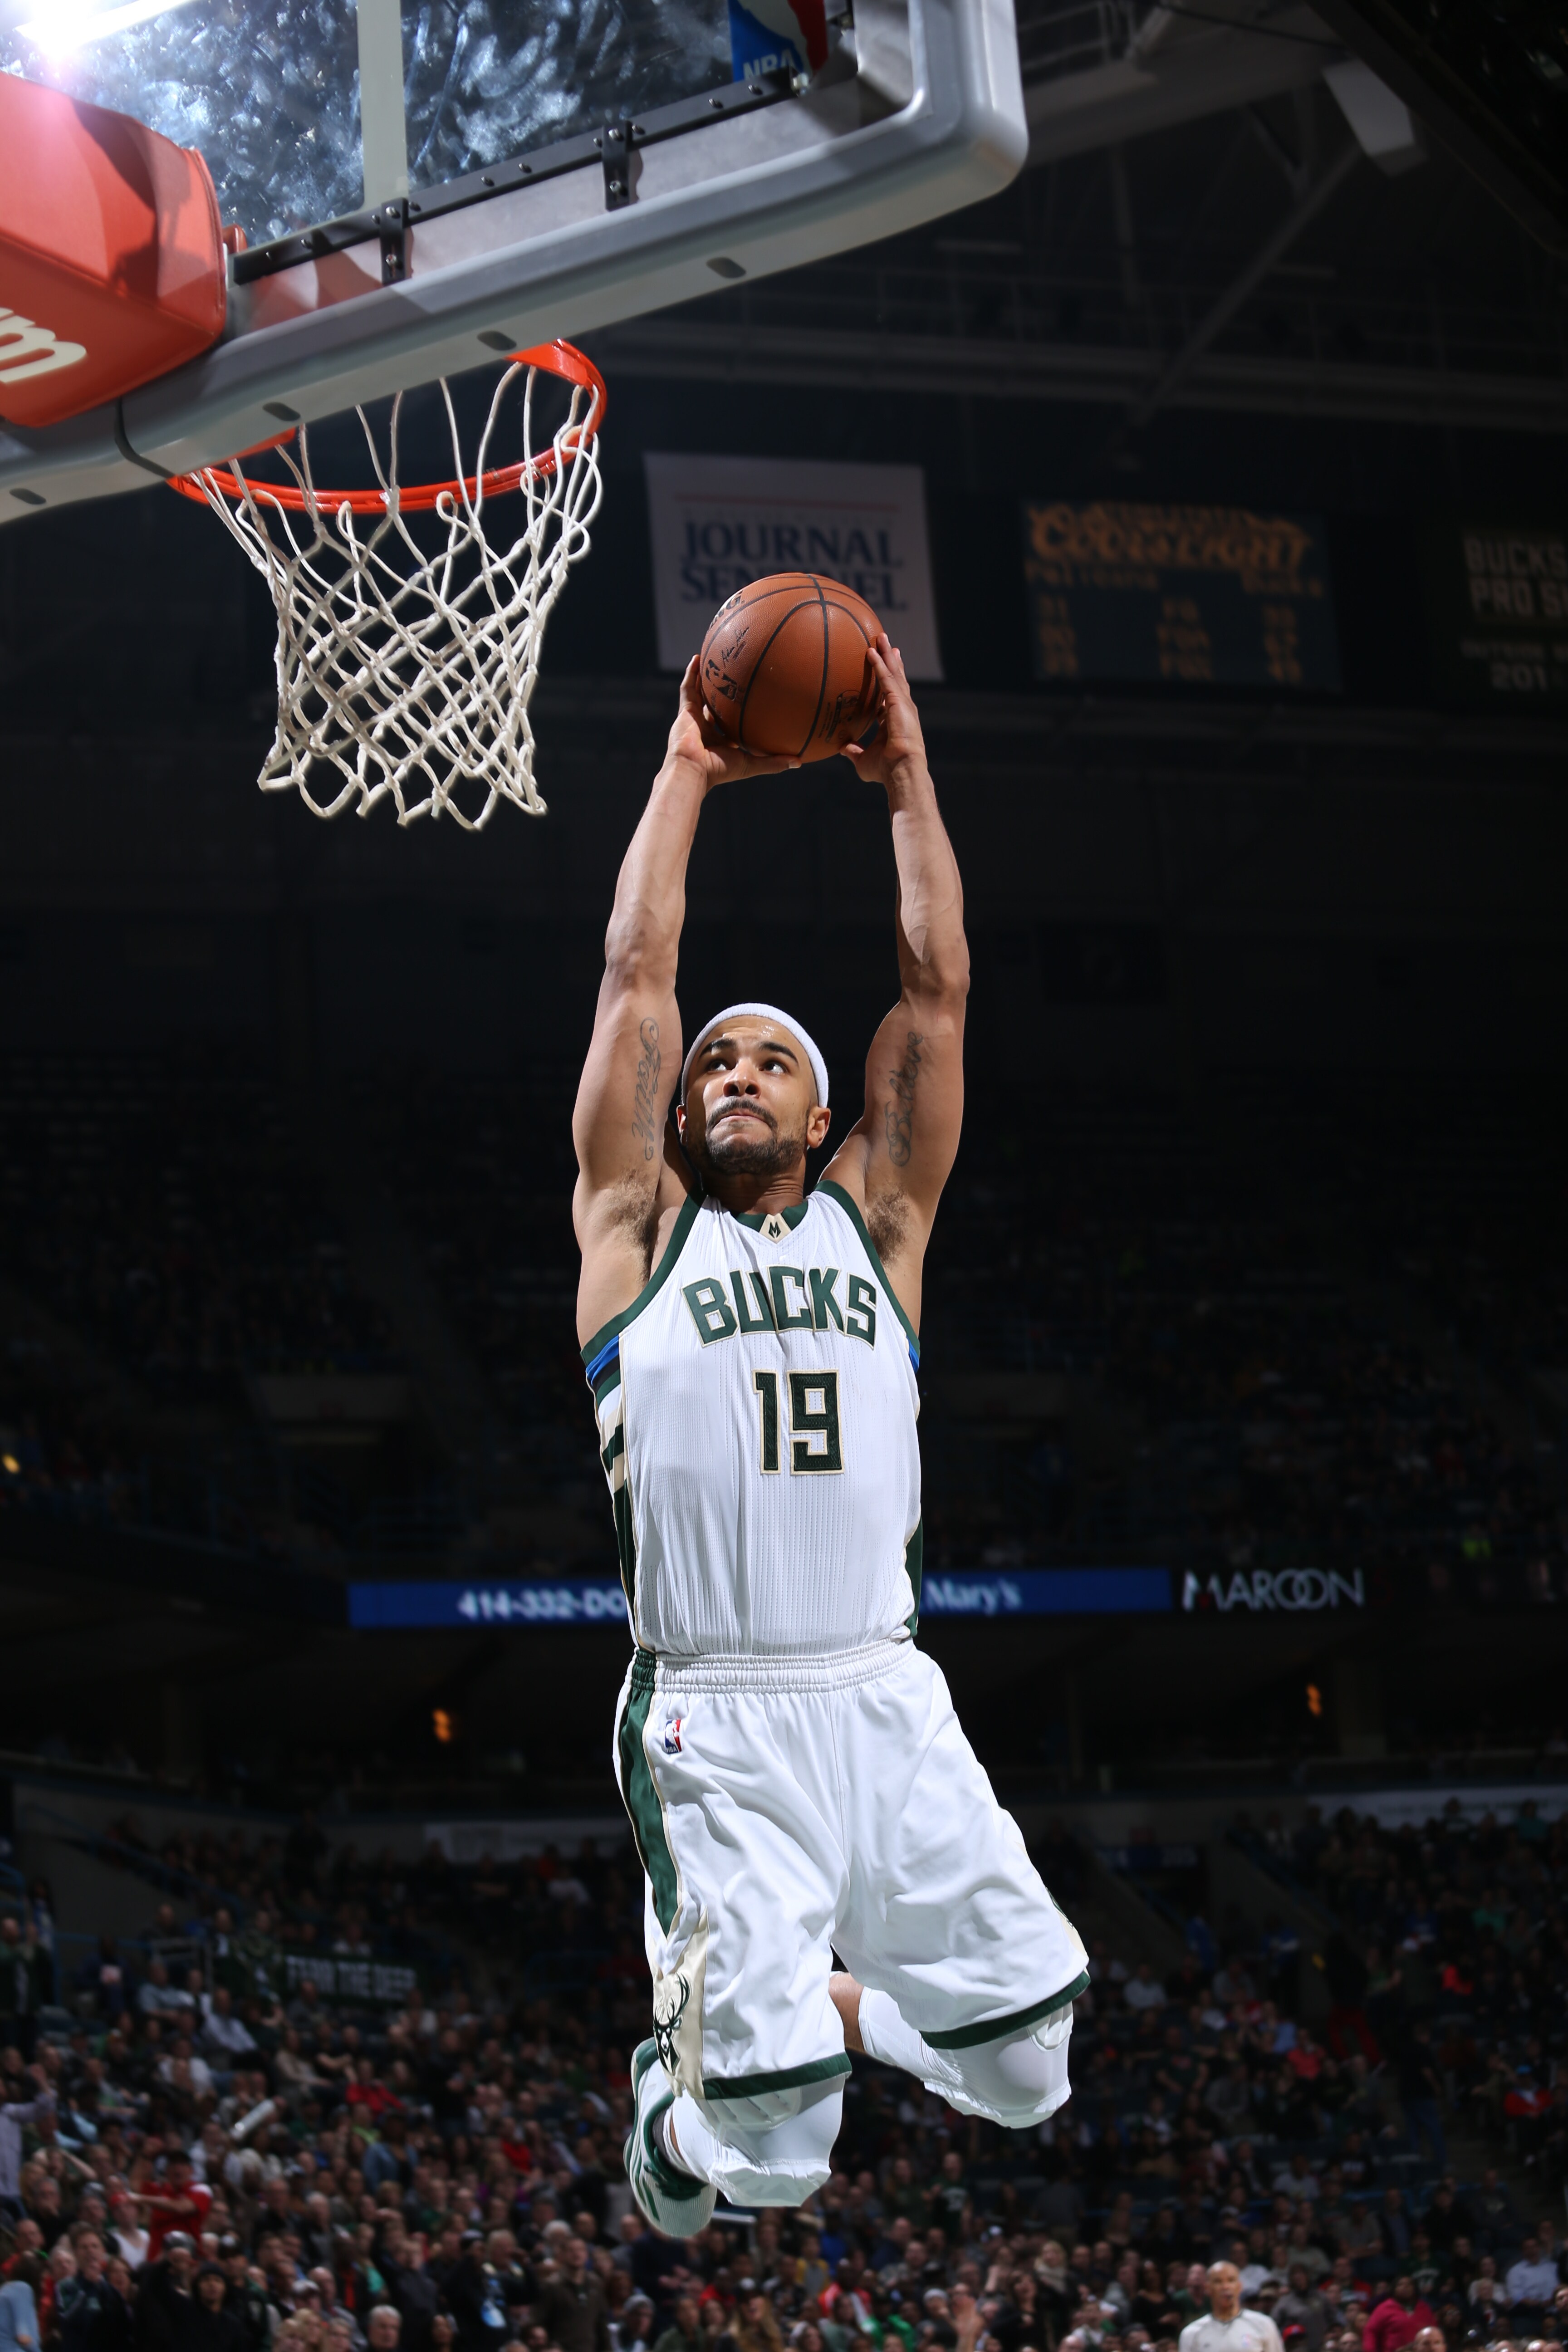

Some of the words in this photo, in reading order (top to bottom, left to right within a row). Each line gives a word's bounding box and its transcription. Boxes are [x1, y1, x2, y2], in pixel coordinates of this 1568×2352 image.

[743, 48, 796, 80] NBA
[680, 519, 904, 568] JOURNAL
[1463, 535, 1568, 579] BUCKS
[1469, 576, 1534, 617] PRO
[885, 1031, 923, 1166] Believe
[680, 1264, 877, 1350] BUCKS
[752, 1369, 845, 1475] 19
[1181, 1566, 1365, 1614] MAROON
